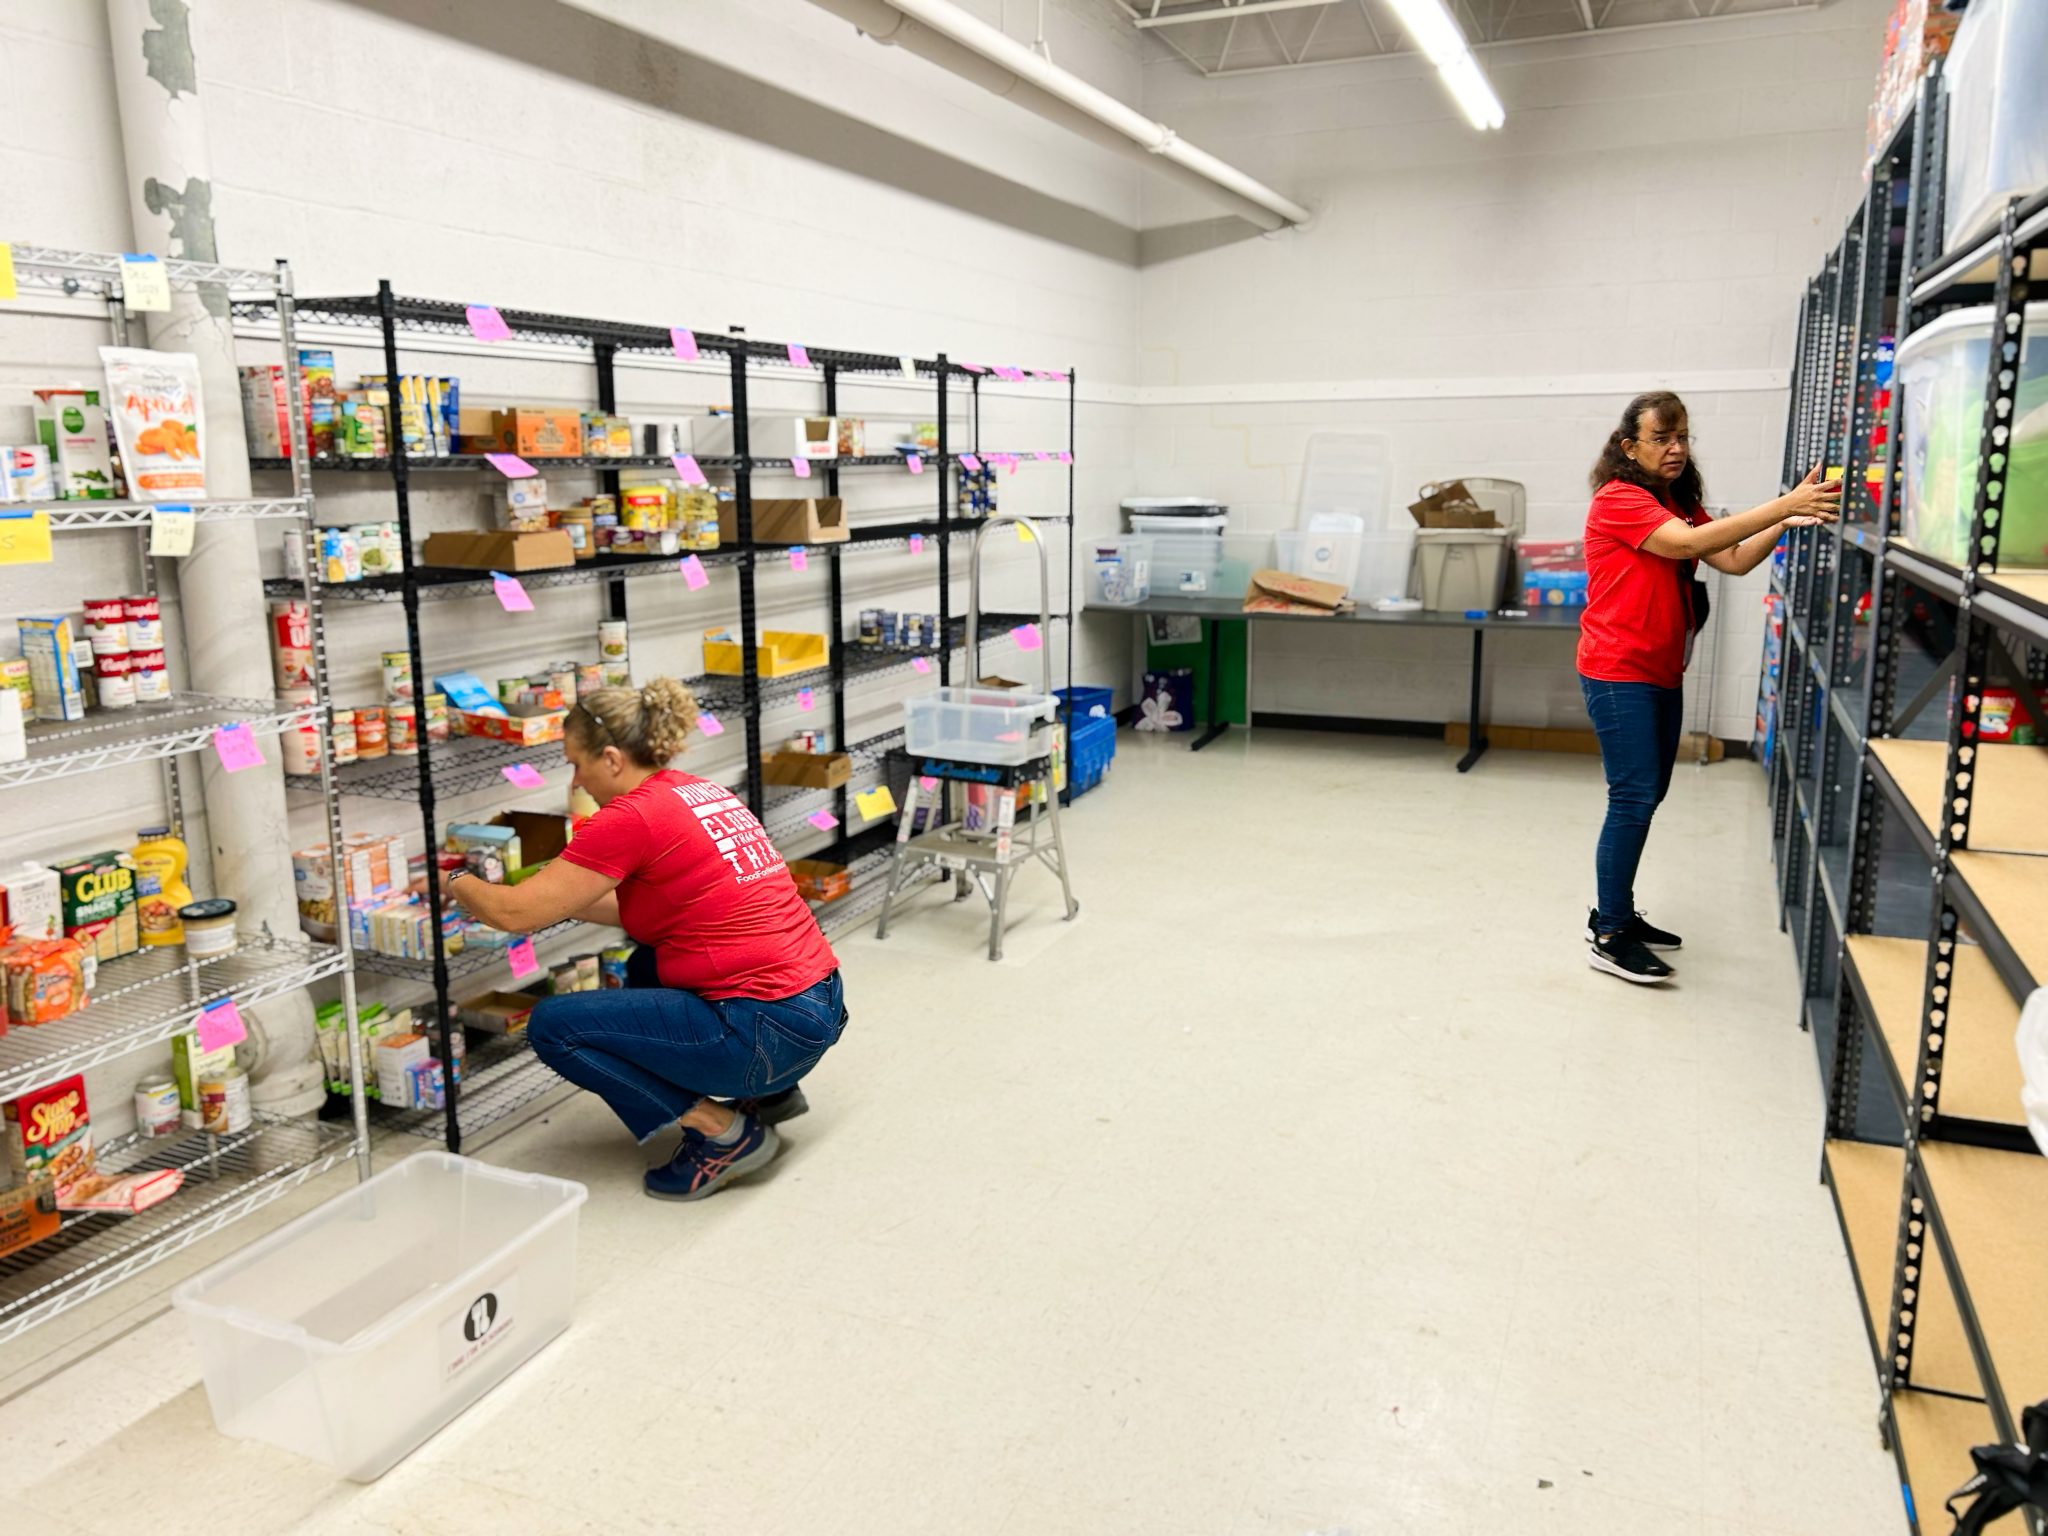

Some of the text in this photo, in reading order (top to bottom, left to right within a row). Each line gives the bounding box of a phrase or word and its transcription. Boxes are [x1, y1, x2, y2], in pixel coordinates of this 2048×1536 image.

[75, 867, 132, 904] CLUB
[26, 1090, 81, 1143] Stove
[47, 1111, 77, 1144] Top
